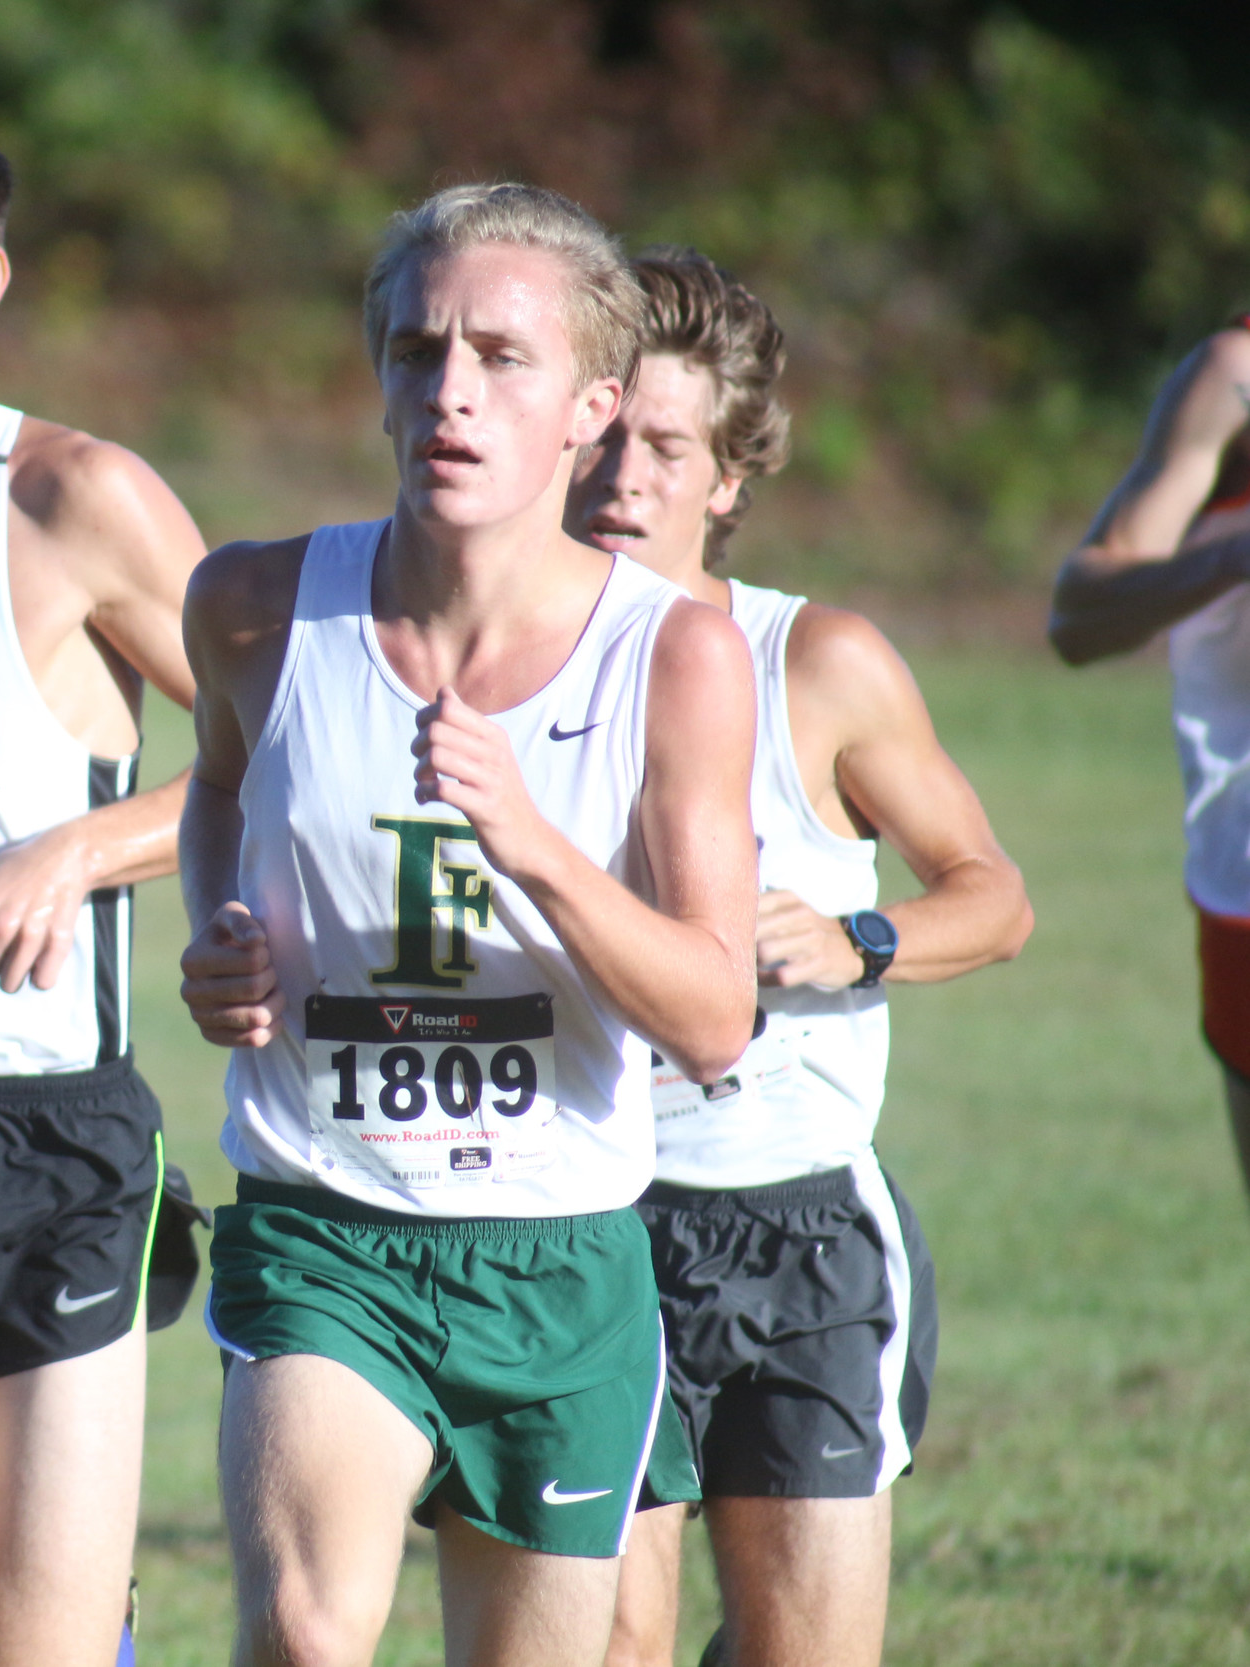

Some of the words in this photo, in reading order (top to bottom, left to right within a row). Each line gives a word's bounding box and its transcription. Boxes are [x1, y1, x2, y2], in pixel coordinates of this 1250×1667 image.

[412, 1013, 477, 1028] RoadID
[331, 1044, 538, 1122] 1809
[360, 1129, 499, 1142] www.RoadID.com
[461, 1155, 481, 1163] FREE
